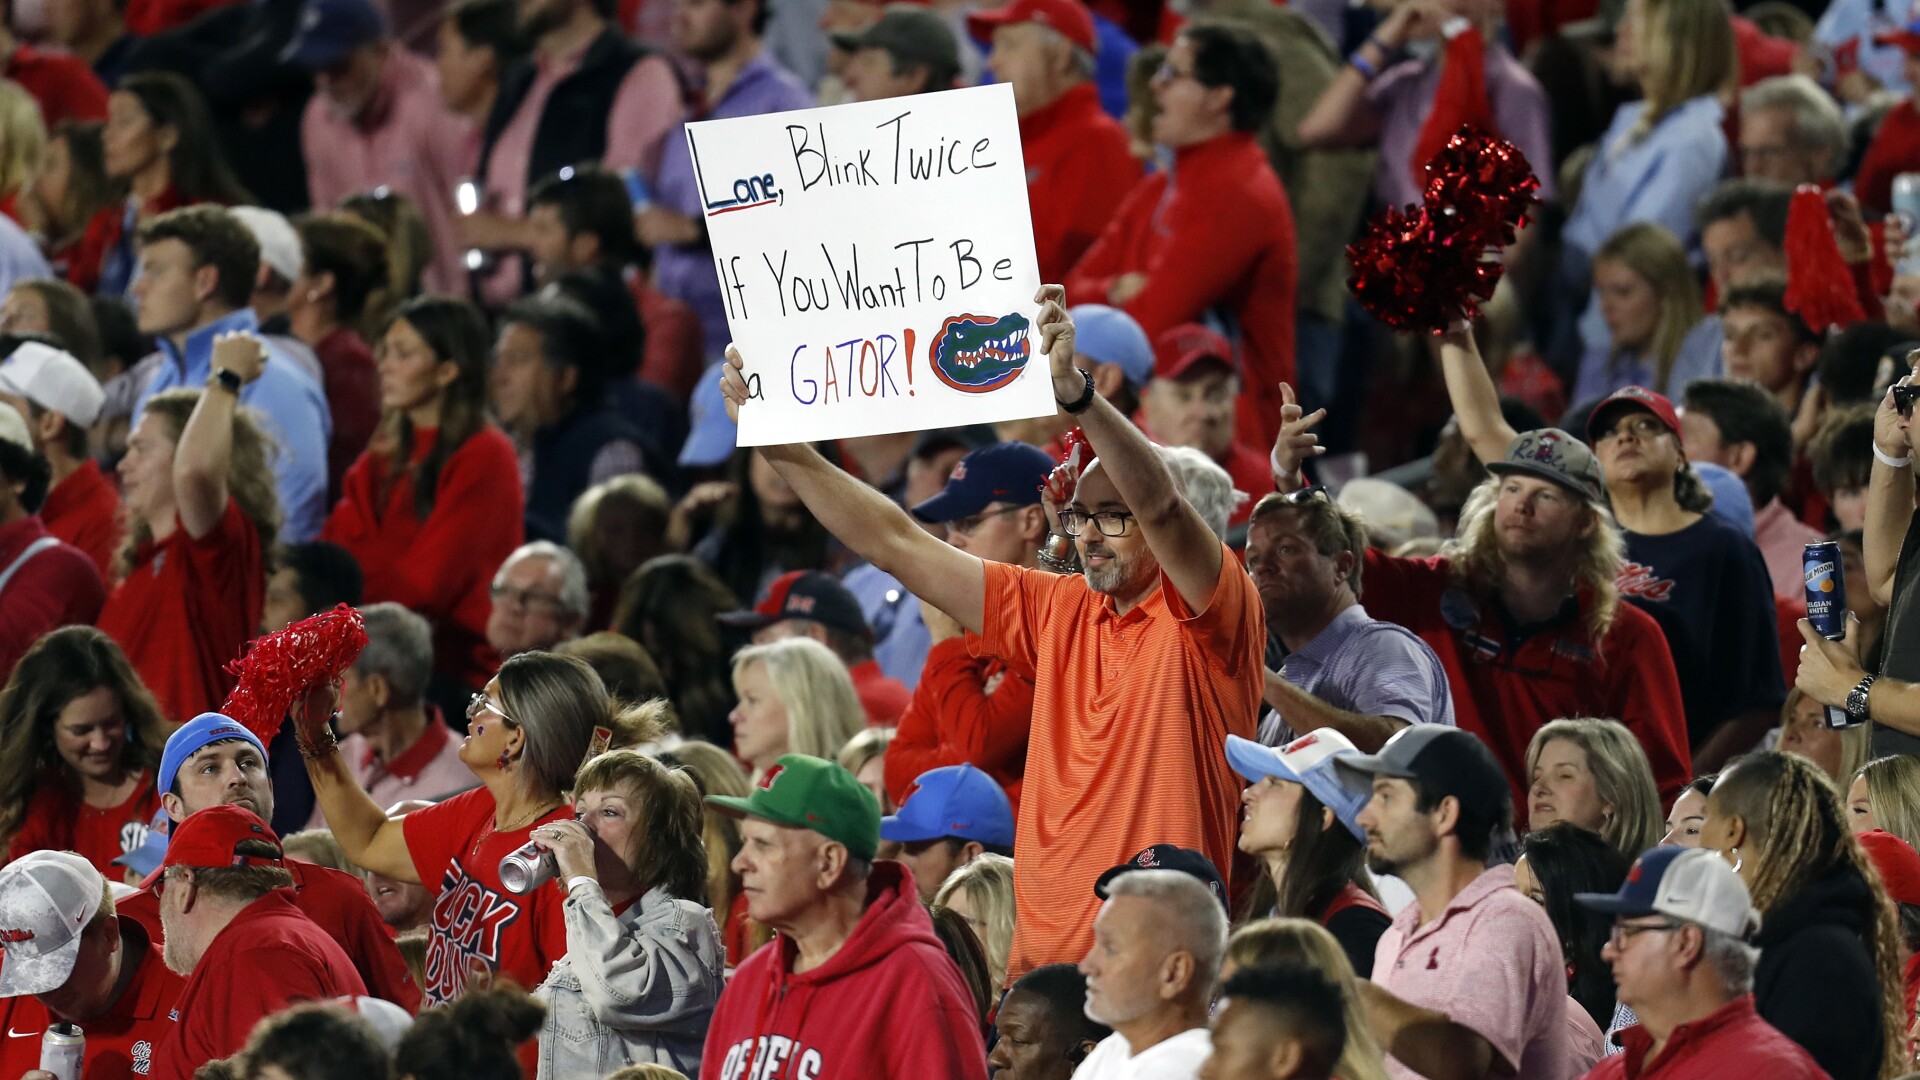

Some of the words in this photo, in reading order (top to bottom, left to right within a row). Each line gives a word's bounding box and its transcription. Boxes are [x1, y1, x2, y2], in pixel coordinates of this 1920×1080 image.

[687, 128, 784, 210] Lane,
[786, 122, 879, 192] Blink
[876, 111, 997, 185] Twice
[719, 256, 749, 320] If
[763, 249, 830, 317] You
[821, 243, 906, 311] Want
[894, 238, 945, 303] To
[949, 239, 1013, 290] Be
[746, 372, 765, 401] a
[790, 328, 916, 405] GATOR!
[1813, 563, 1833, 576] MOON
[426, 925, 492, 1000] OUND
[131, 1040, 151, 1056] Ole
